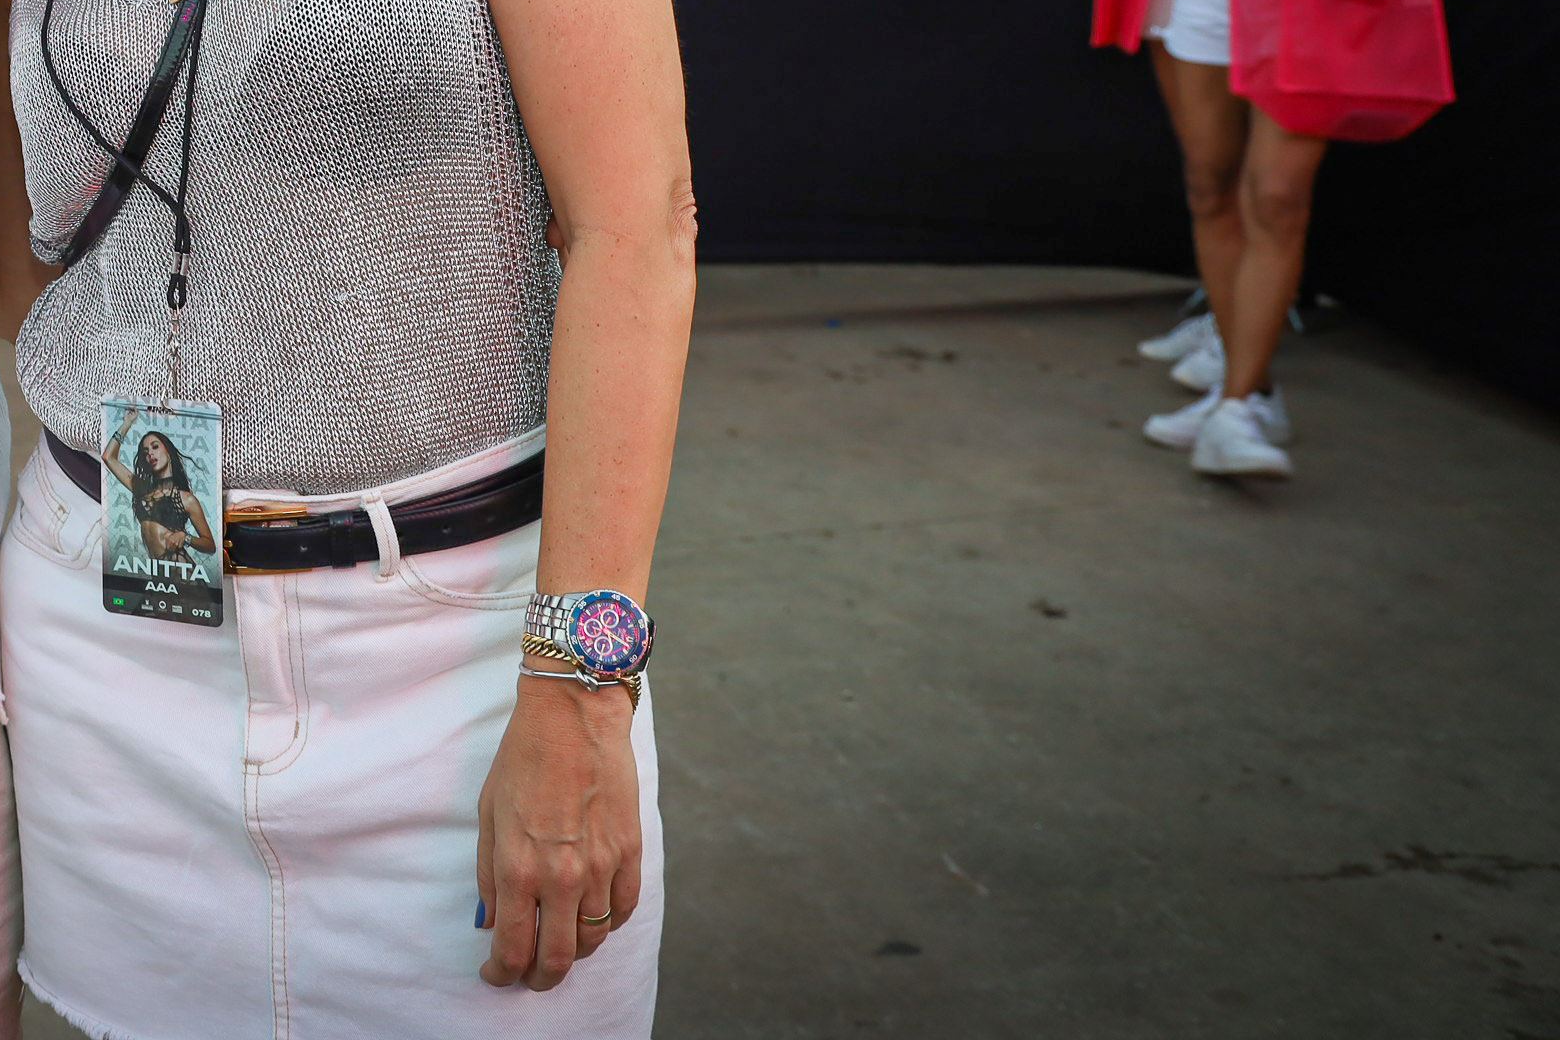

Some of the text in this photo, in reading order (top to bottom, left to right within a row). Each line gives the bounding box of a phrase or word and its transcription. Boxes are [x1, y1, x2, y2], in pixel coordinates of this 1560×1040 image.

[113, 555, 211, 584] ANITTA
[145, 581, 179, 595] AAA
[191, 608, 212, 619] 078
